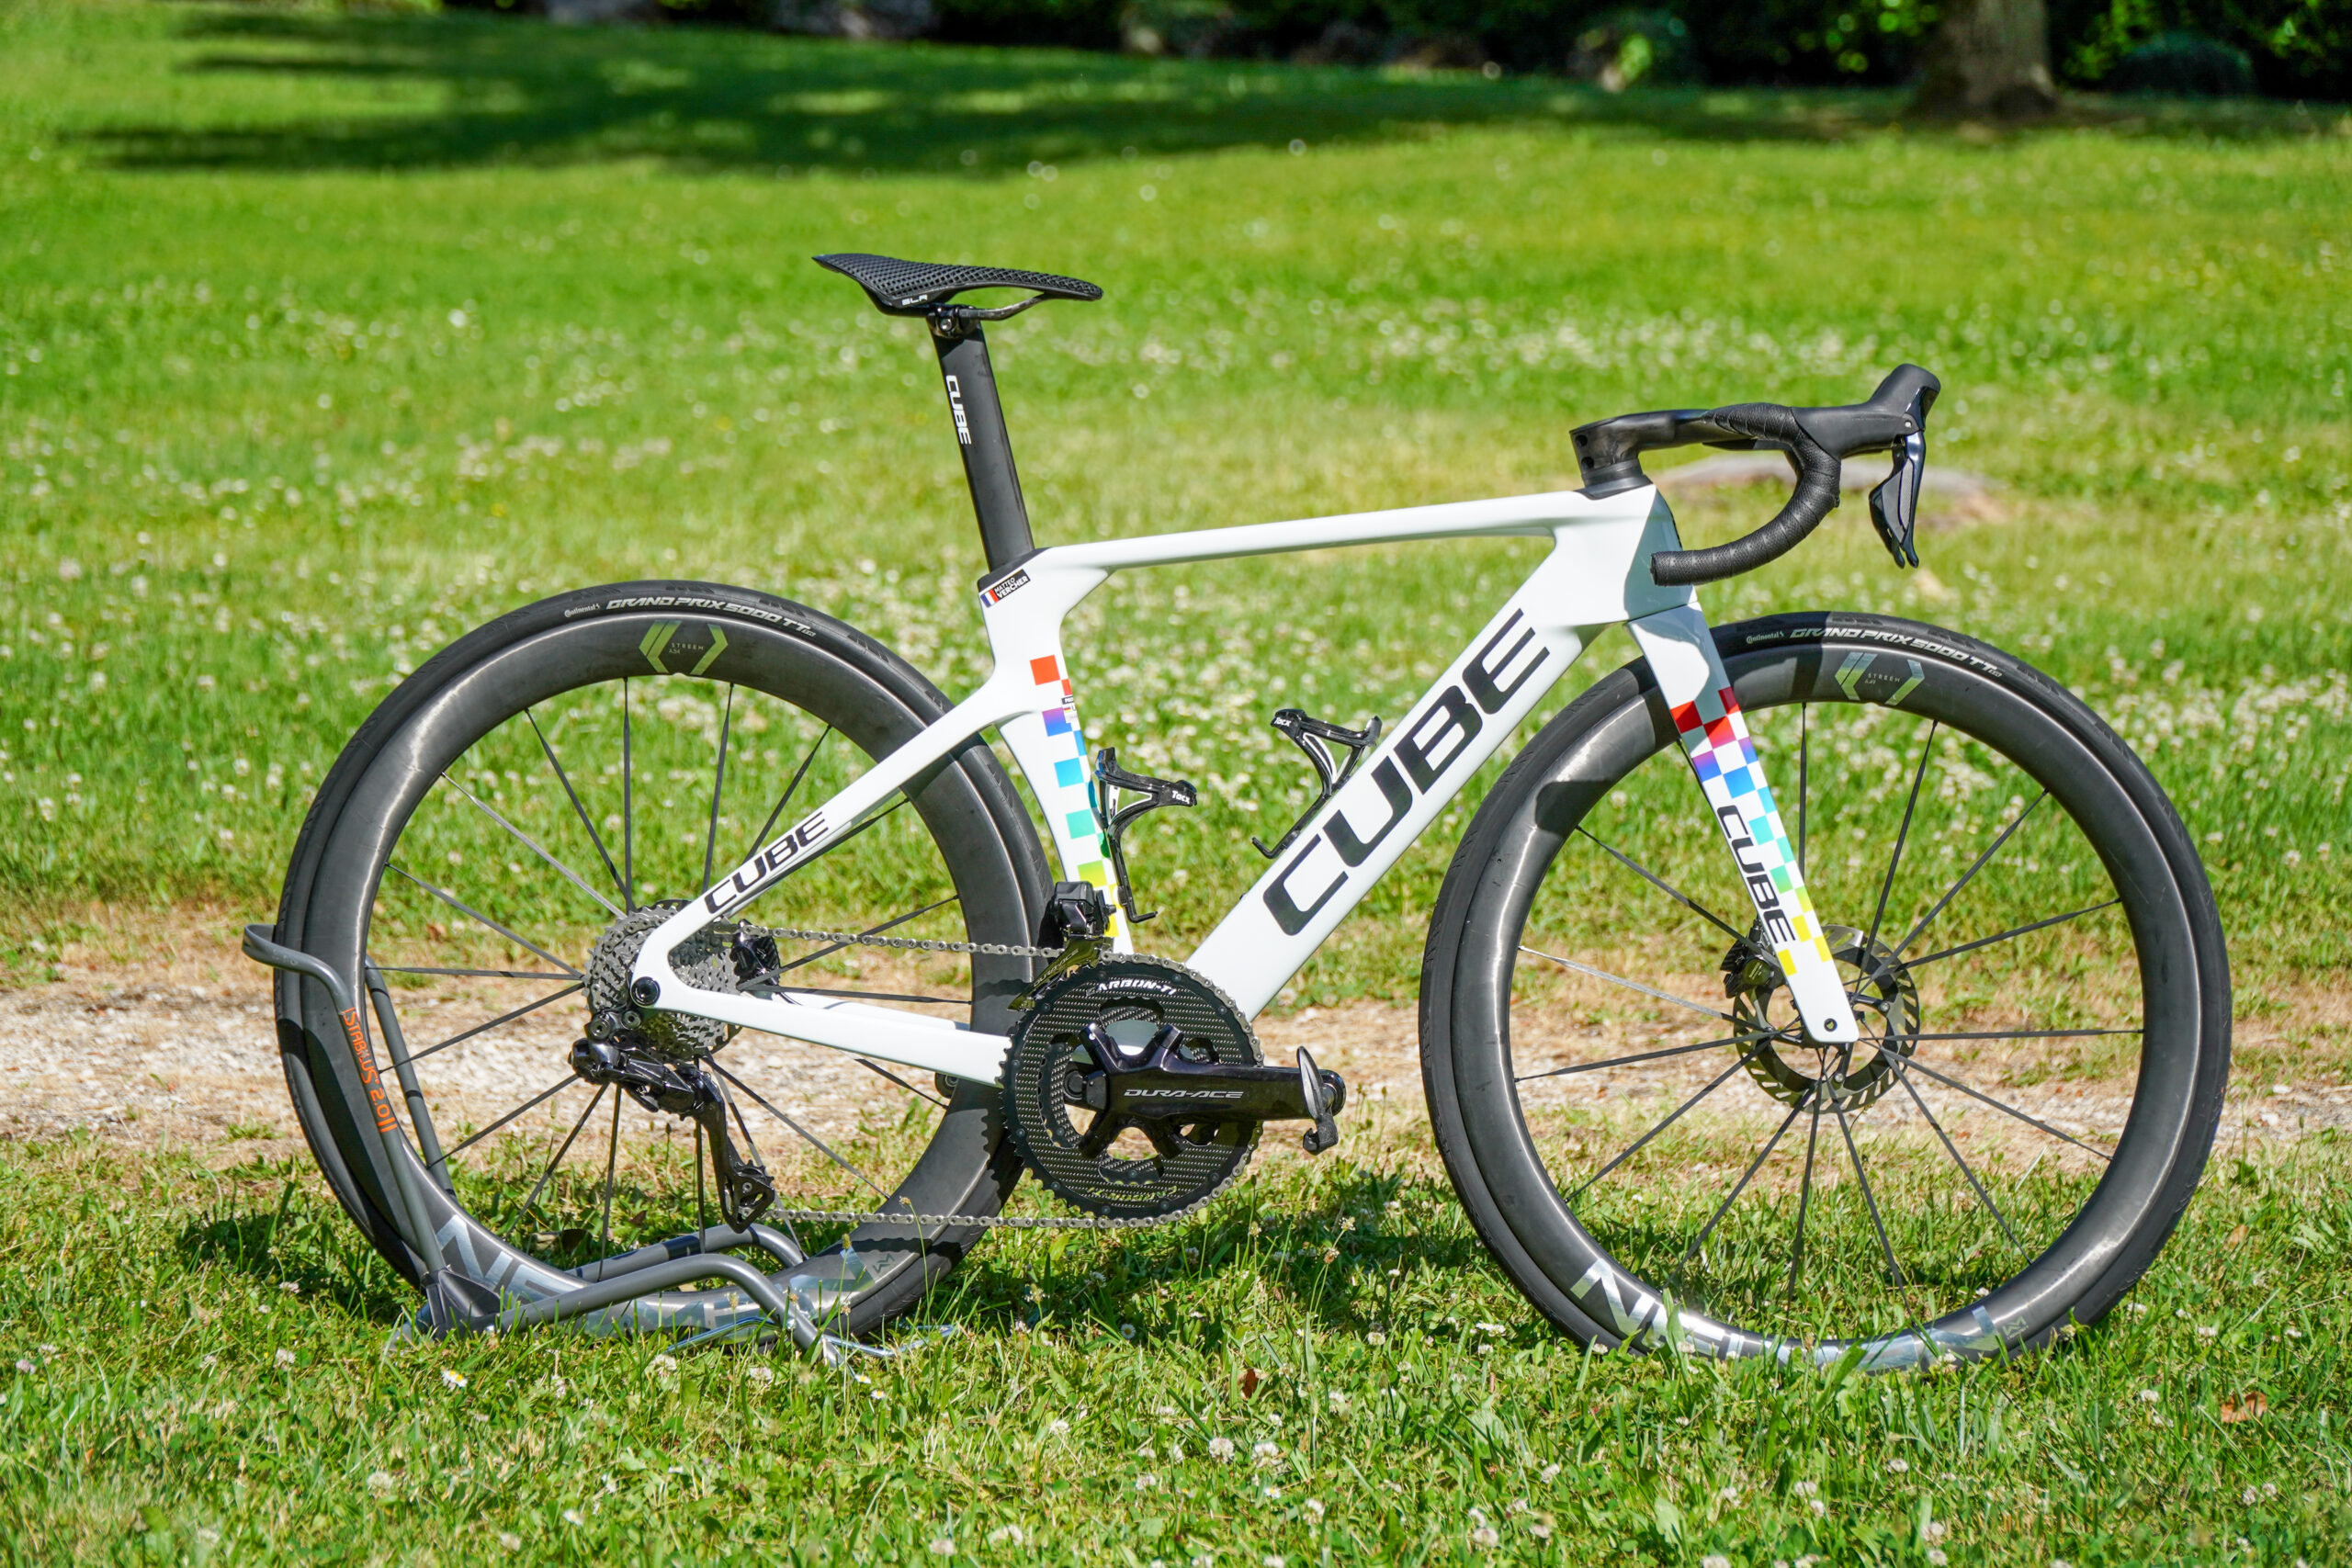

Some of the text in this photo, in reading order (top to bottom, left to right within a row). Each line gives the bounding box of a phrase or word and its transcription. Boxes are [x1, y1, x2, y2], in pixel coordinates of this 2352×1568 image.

[901, 294, 928, 306] SLR
[945, 375, 972, 445] CUBE
[994, 577, 1017, 593] MATTEO
[996, 575, 1029, 600] VERCHER
[564, 604, 595, 618] Continental
[606, 596, 673, 610] GRAND
[673, 597, 726, 610] PRIX
[722, 603, 783, 623] 5000
[783, 618, 811, 632] TT
[1746, 631, 1779, 644] Continental
[1790, 627, 1860, 638] GRAND
[1860, 630, 1914, 646] PRIX
[1909, 637, 1970, 661] 5000
[1969, 656, 1997, 671] TT
[1273, 716, 1292, 728] Tacx
[1263, 608, 1551, 936] CUBE
[1171, 790, 1191, 805] Tacx
[704, 811, 829, 914] CUBE
[1717, 805, 1796, 944] CUBE
[1124, 1089, 1245, 1100] DURA-ACE
